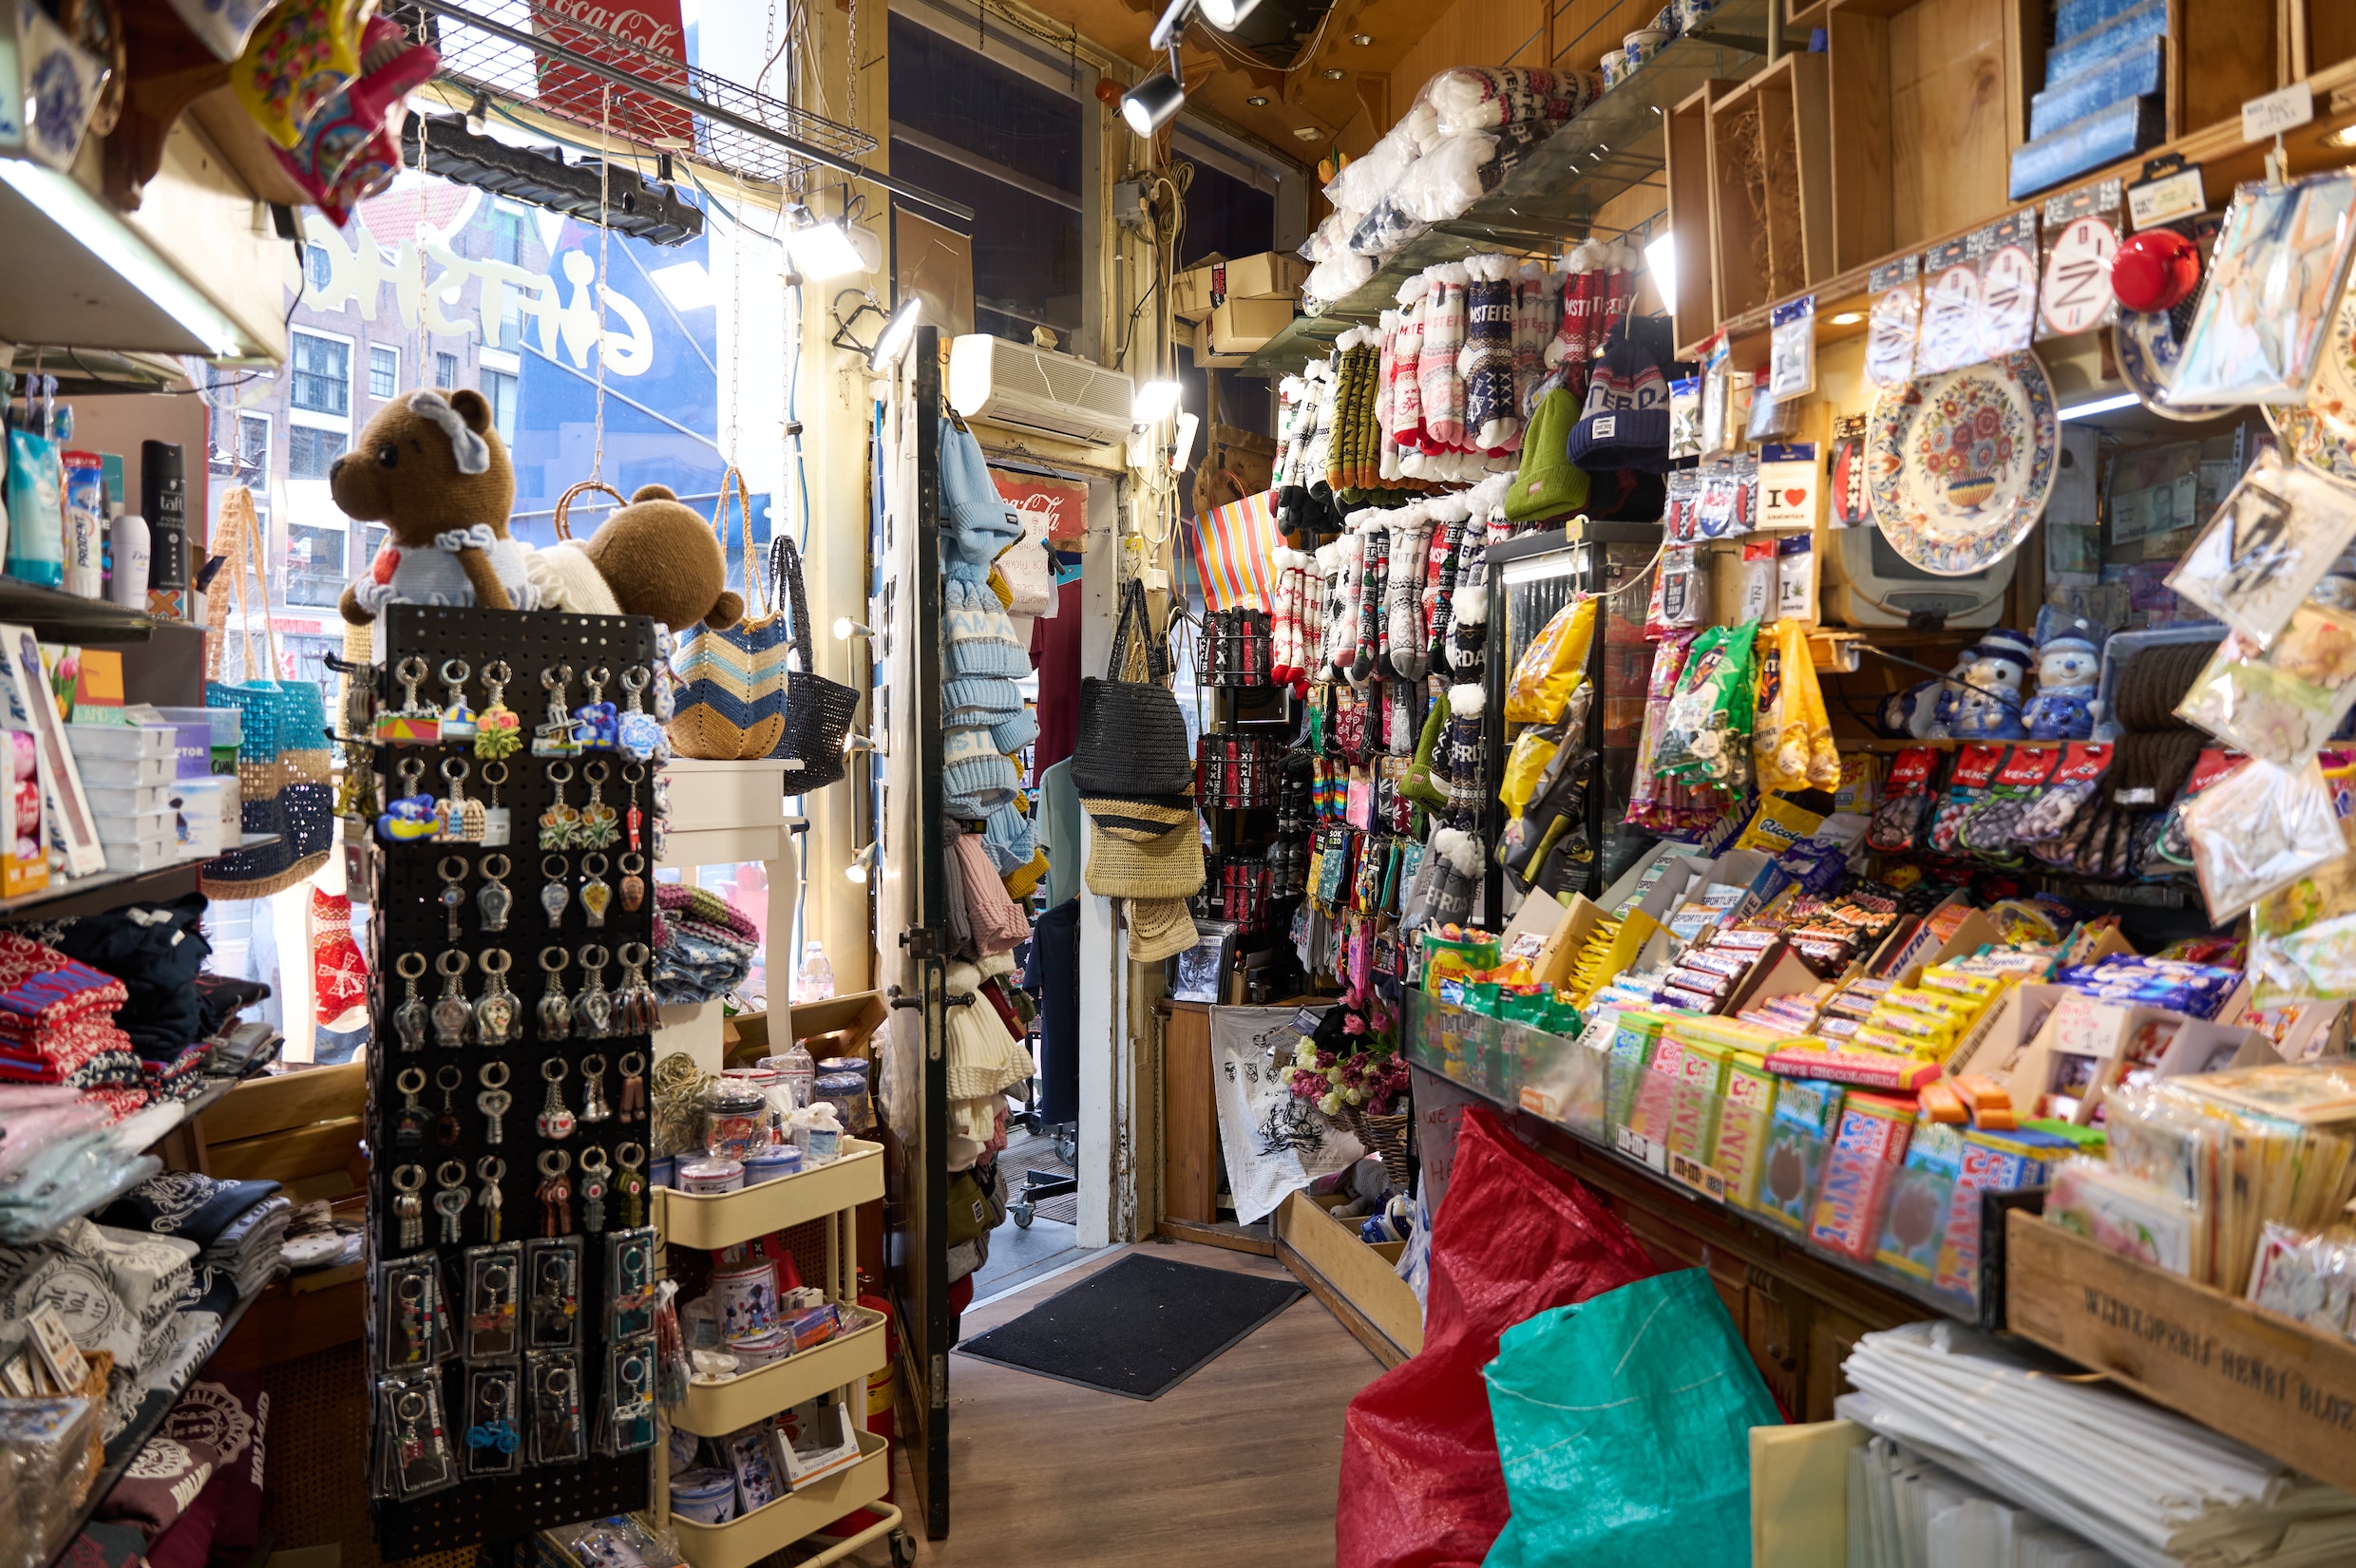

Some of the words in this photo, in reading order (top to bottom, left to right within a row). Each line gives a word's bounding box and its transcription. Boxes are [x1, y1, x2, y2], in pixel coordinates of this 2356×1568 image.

[160, 495, 184, 511] taft
[1768, 489, 1781, 508] I
[1767, 513, 1804, 521] Amsterdam
[73, 514, 90, 568] PRODENT
[1017, 542, 1046, 553] AITING
[1329, 829, 1342, 838] SOK
[1701, 896, 1738, 906] SPORTLIFE
[1768, 1059, 1807, 1074] TONY'S
[251, 1390, 271, 1494] HOLLAND
[804, 1449, 846, 1473] Stroopwafels
